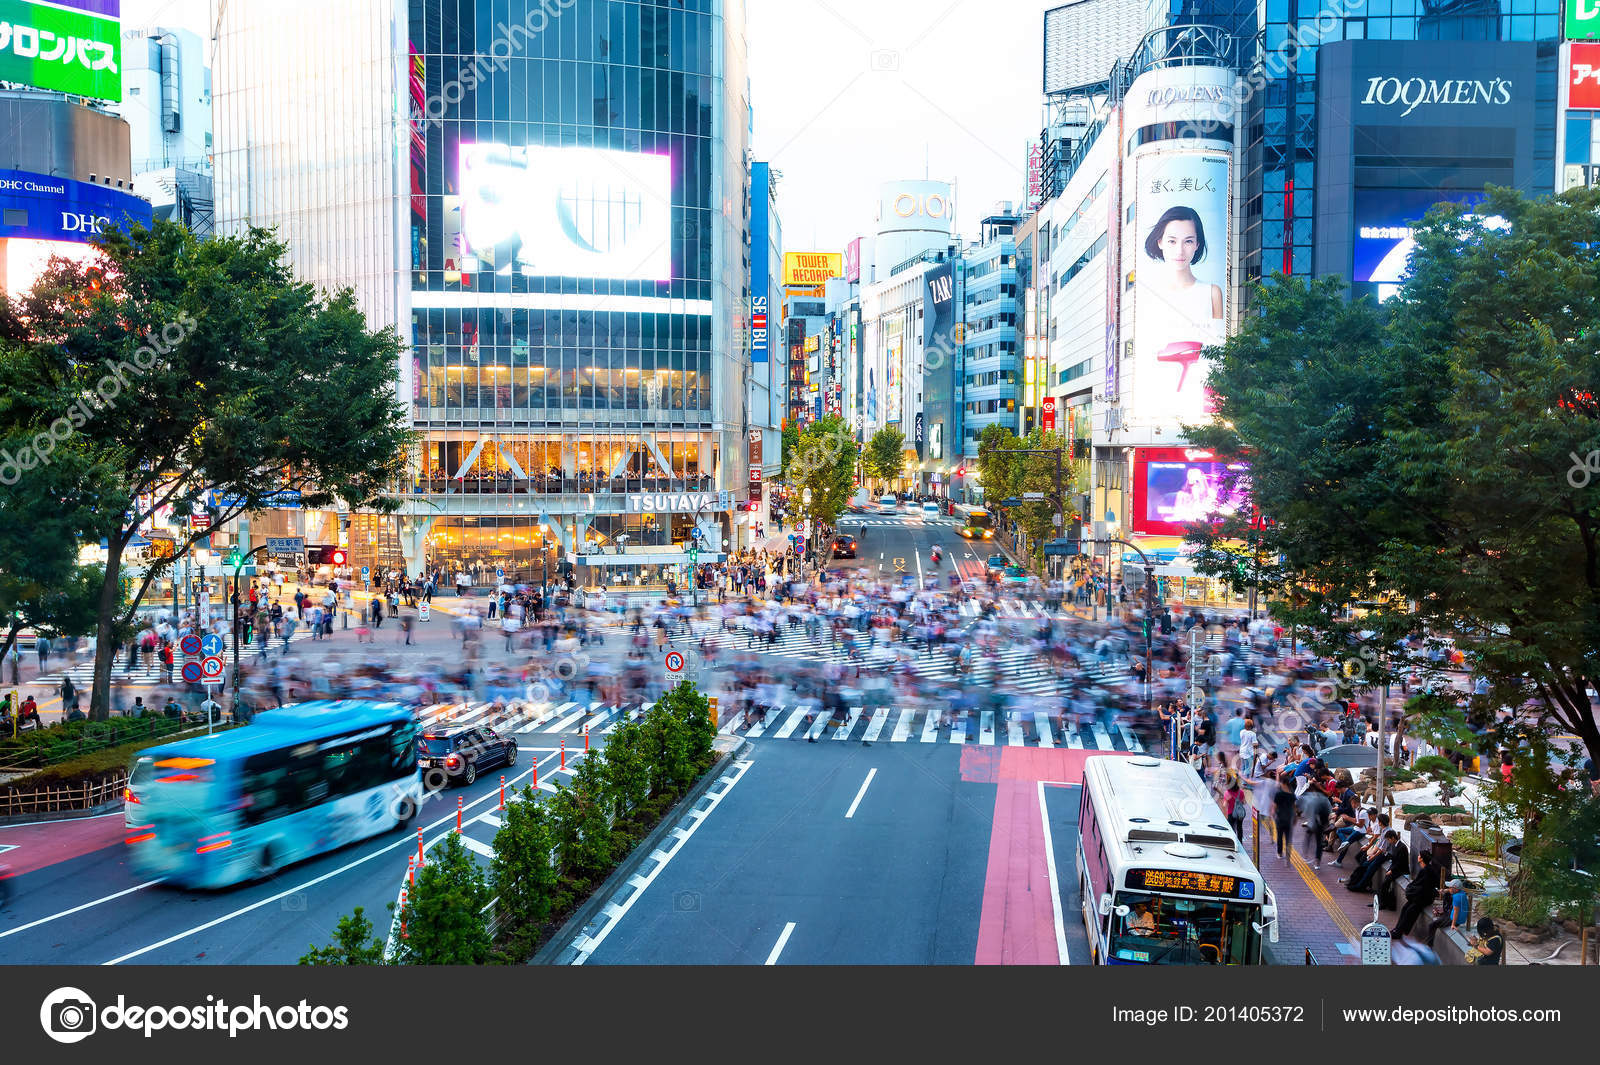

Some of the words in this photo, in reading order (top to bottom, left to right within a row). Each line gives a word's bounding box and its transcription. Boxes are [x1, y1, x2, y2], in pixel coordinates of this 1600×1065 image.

[1028, 143, 1041, 197] 大和証券
[1202, 156, 1228, 165] Panasonic
[0, 179, 23, 190] DHC
[24, 181, 65, 194] Channel
[61, 211, 110, 234] DHC
[796, 255, 829, 268] TOWER
[792, 268, 835, 282] RECORDS
[752, 296, 767, 351] SEIBU
[823, 325, 831, 369] KARAOKE
[915, 416, 923, 442] ZARA
[630, 494, 712, 512] TSUTAYA
